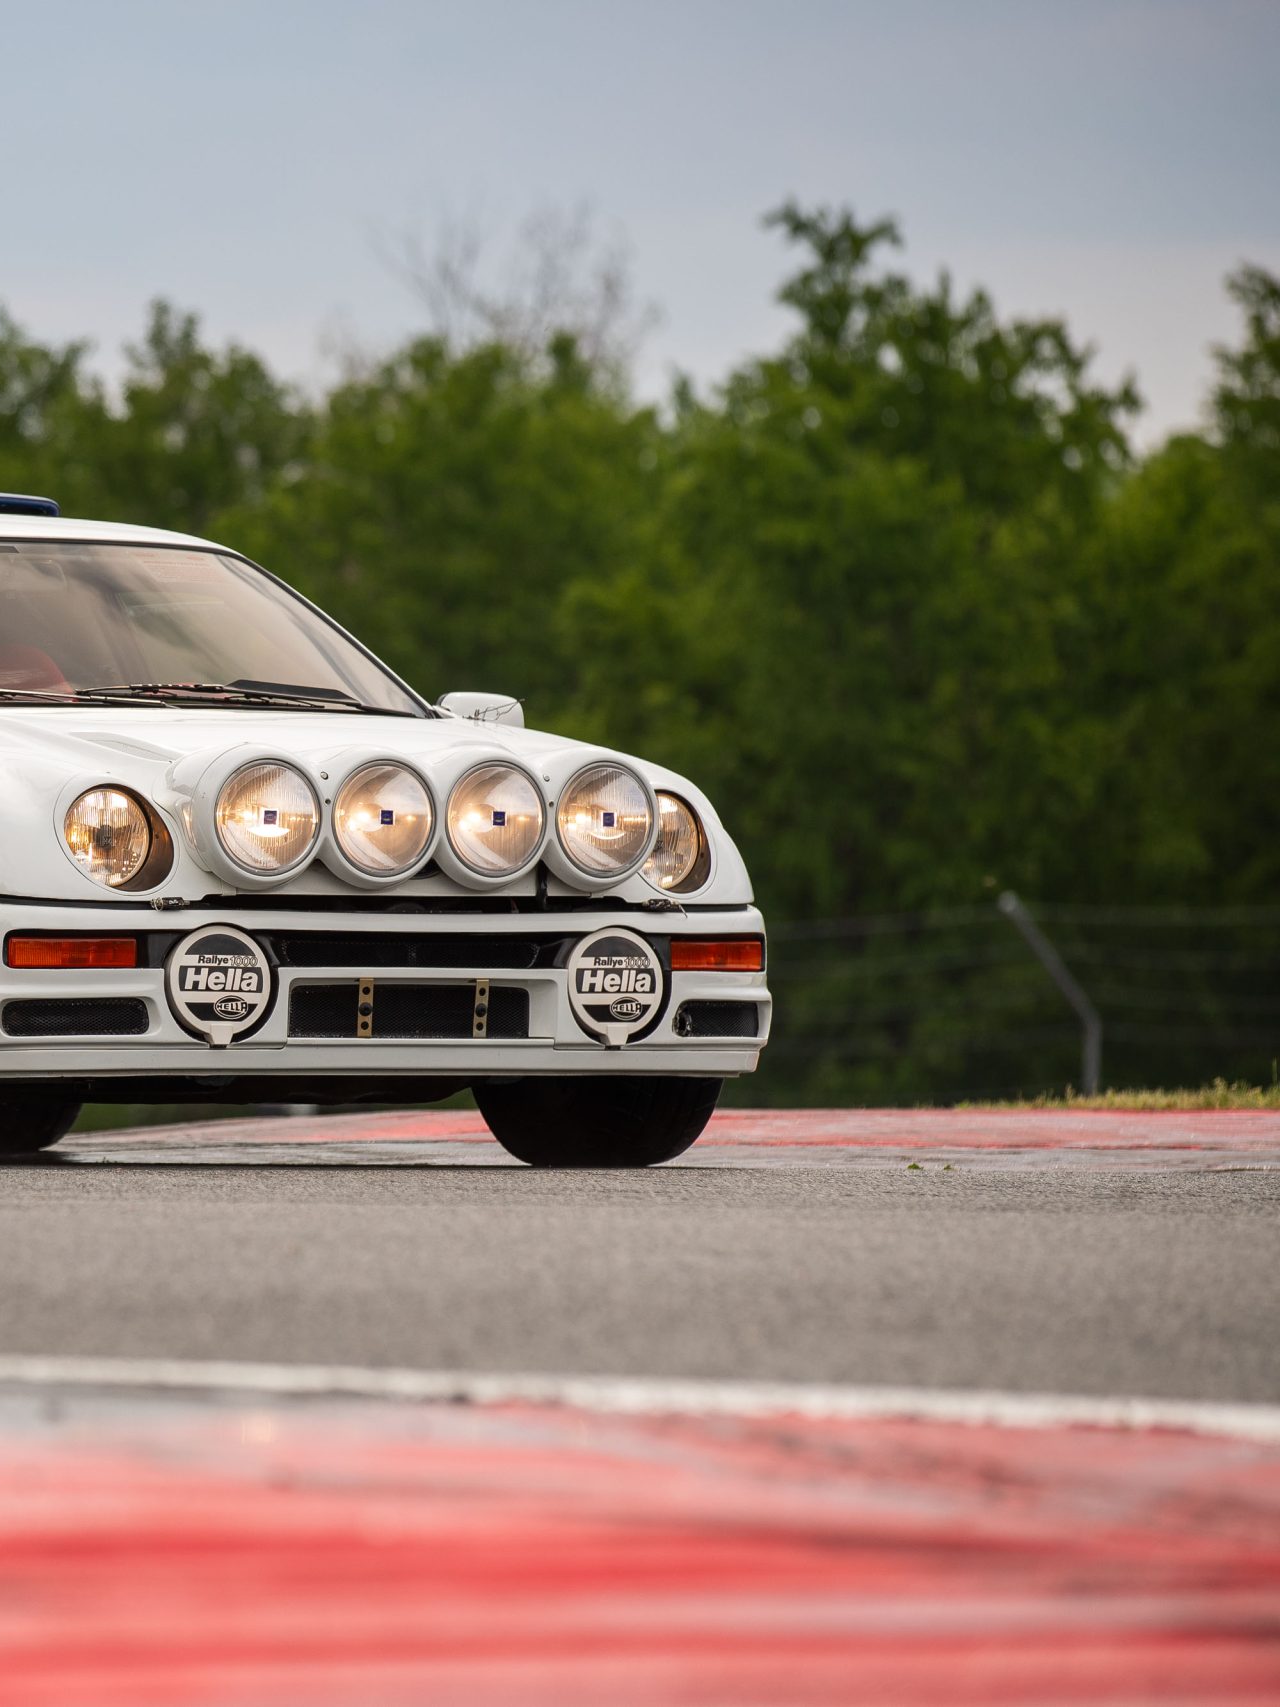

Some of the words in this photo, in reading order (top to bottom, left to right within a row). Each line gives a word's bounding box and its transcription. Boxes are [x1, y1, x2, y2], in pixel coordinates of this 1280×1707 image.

[198, 955, 228, 966] Rallye
[230, 955, 258, 967] 1000
[593, 957, 623, 968] Rallye
[624, 957, 651, 969] 1000
[184, 967, 258, 991] Hella
[581, 969, 651, 993] Hella
[216, 1001, 248, 1013] HELLA
[612, 1002, 642, 1013] HELLA
